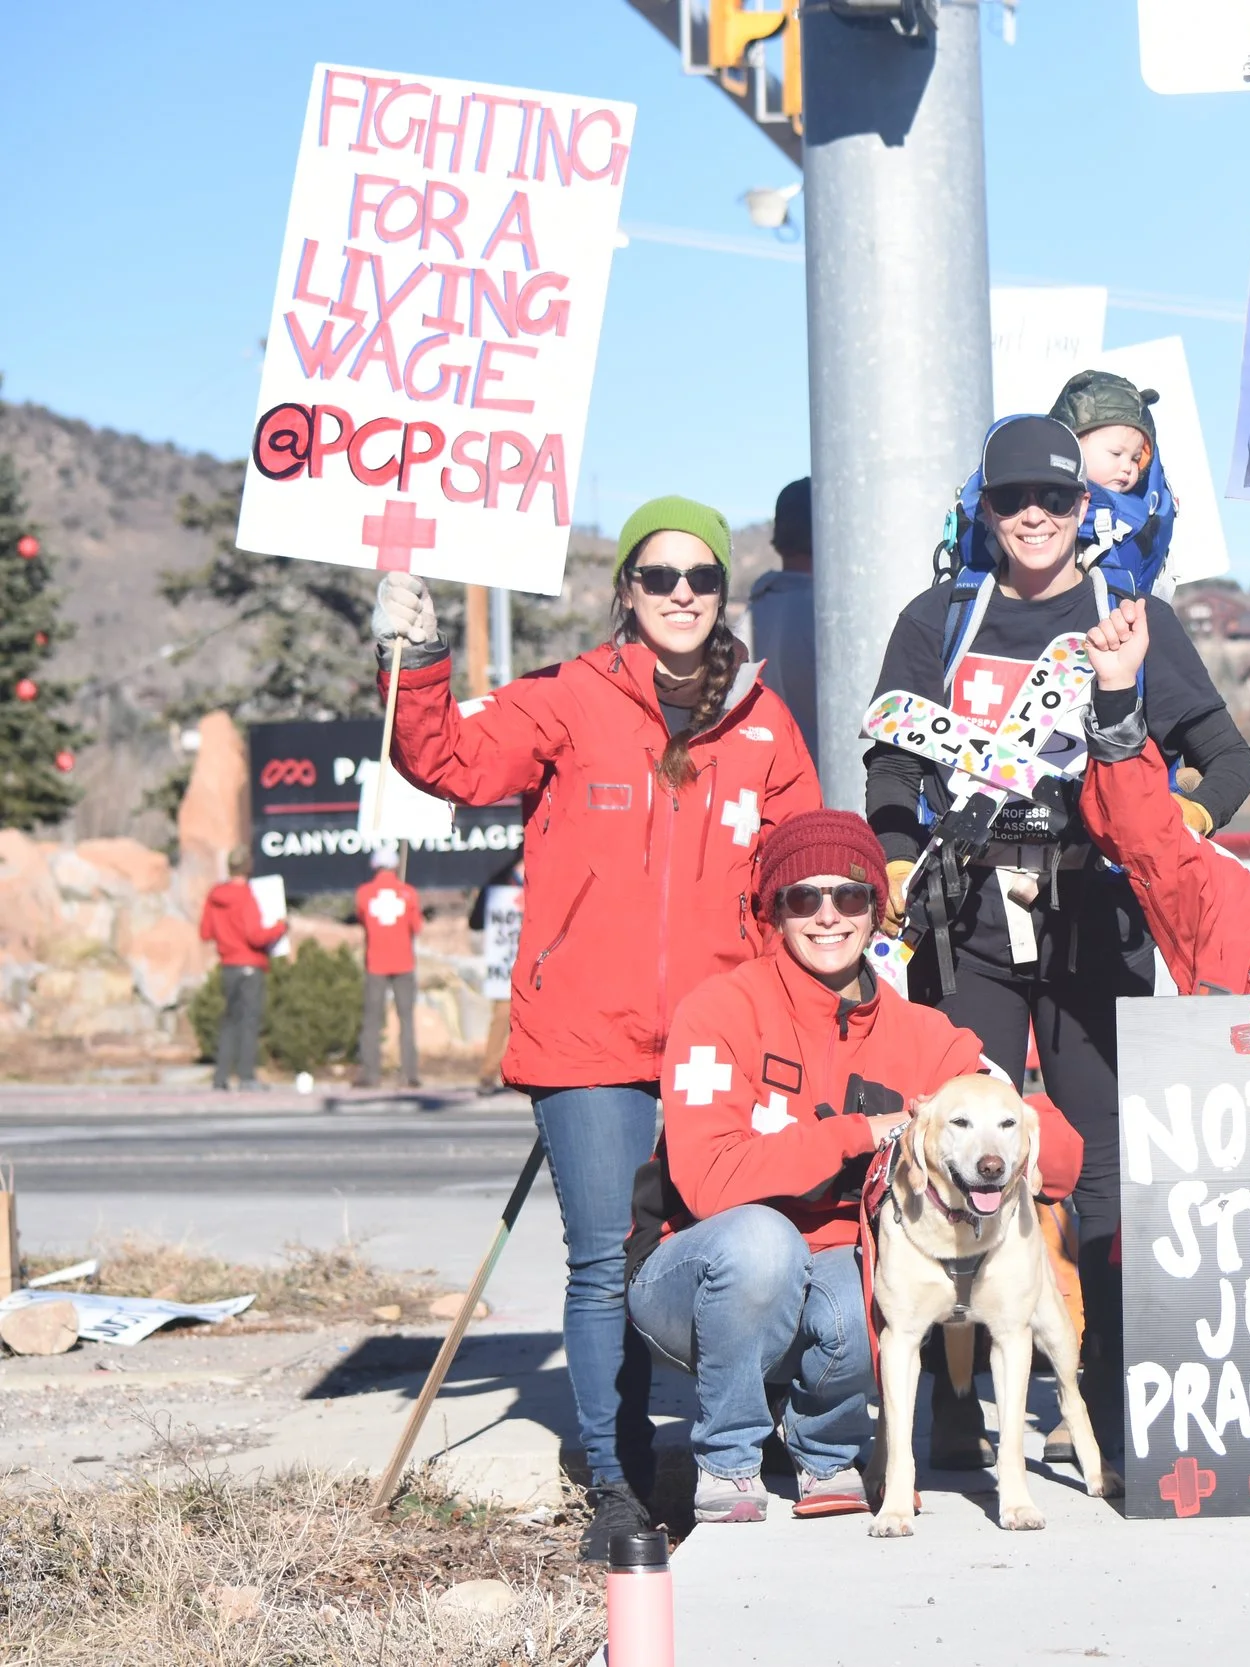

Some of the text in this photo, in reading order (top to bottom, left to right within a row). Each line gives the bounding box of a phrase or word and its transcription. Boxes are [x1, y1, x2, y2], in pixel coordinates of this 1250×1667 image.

[318, 69, 631, 187] FIGHTING
[348, 172, 540, 271] FOR A
[292, 237, 571, 338] LIVING
[283, 311, 539, 414] WAGE
[252, 402, 571, 526] @PCPSPA
